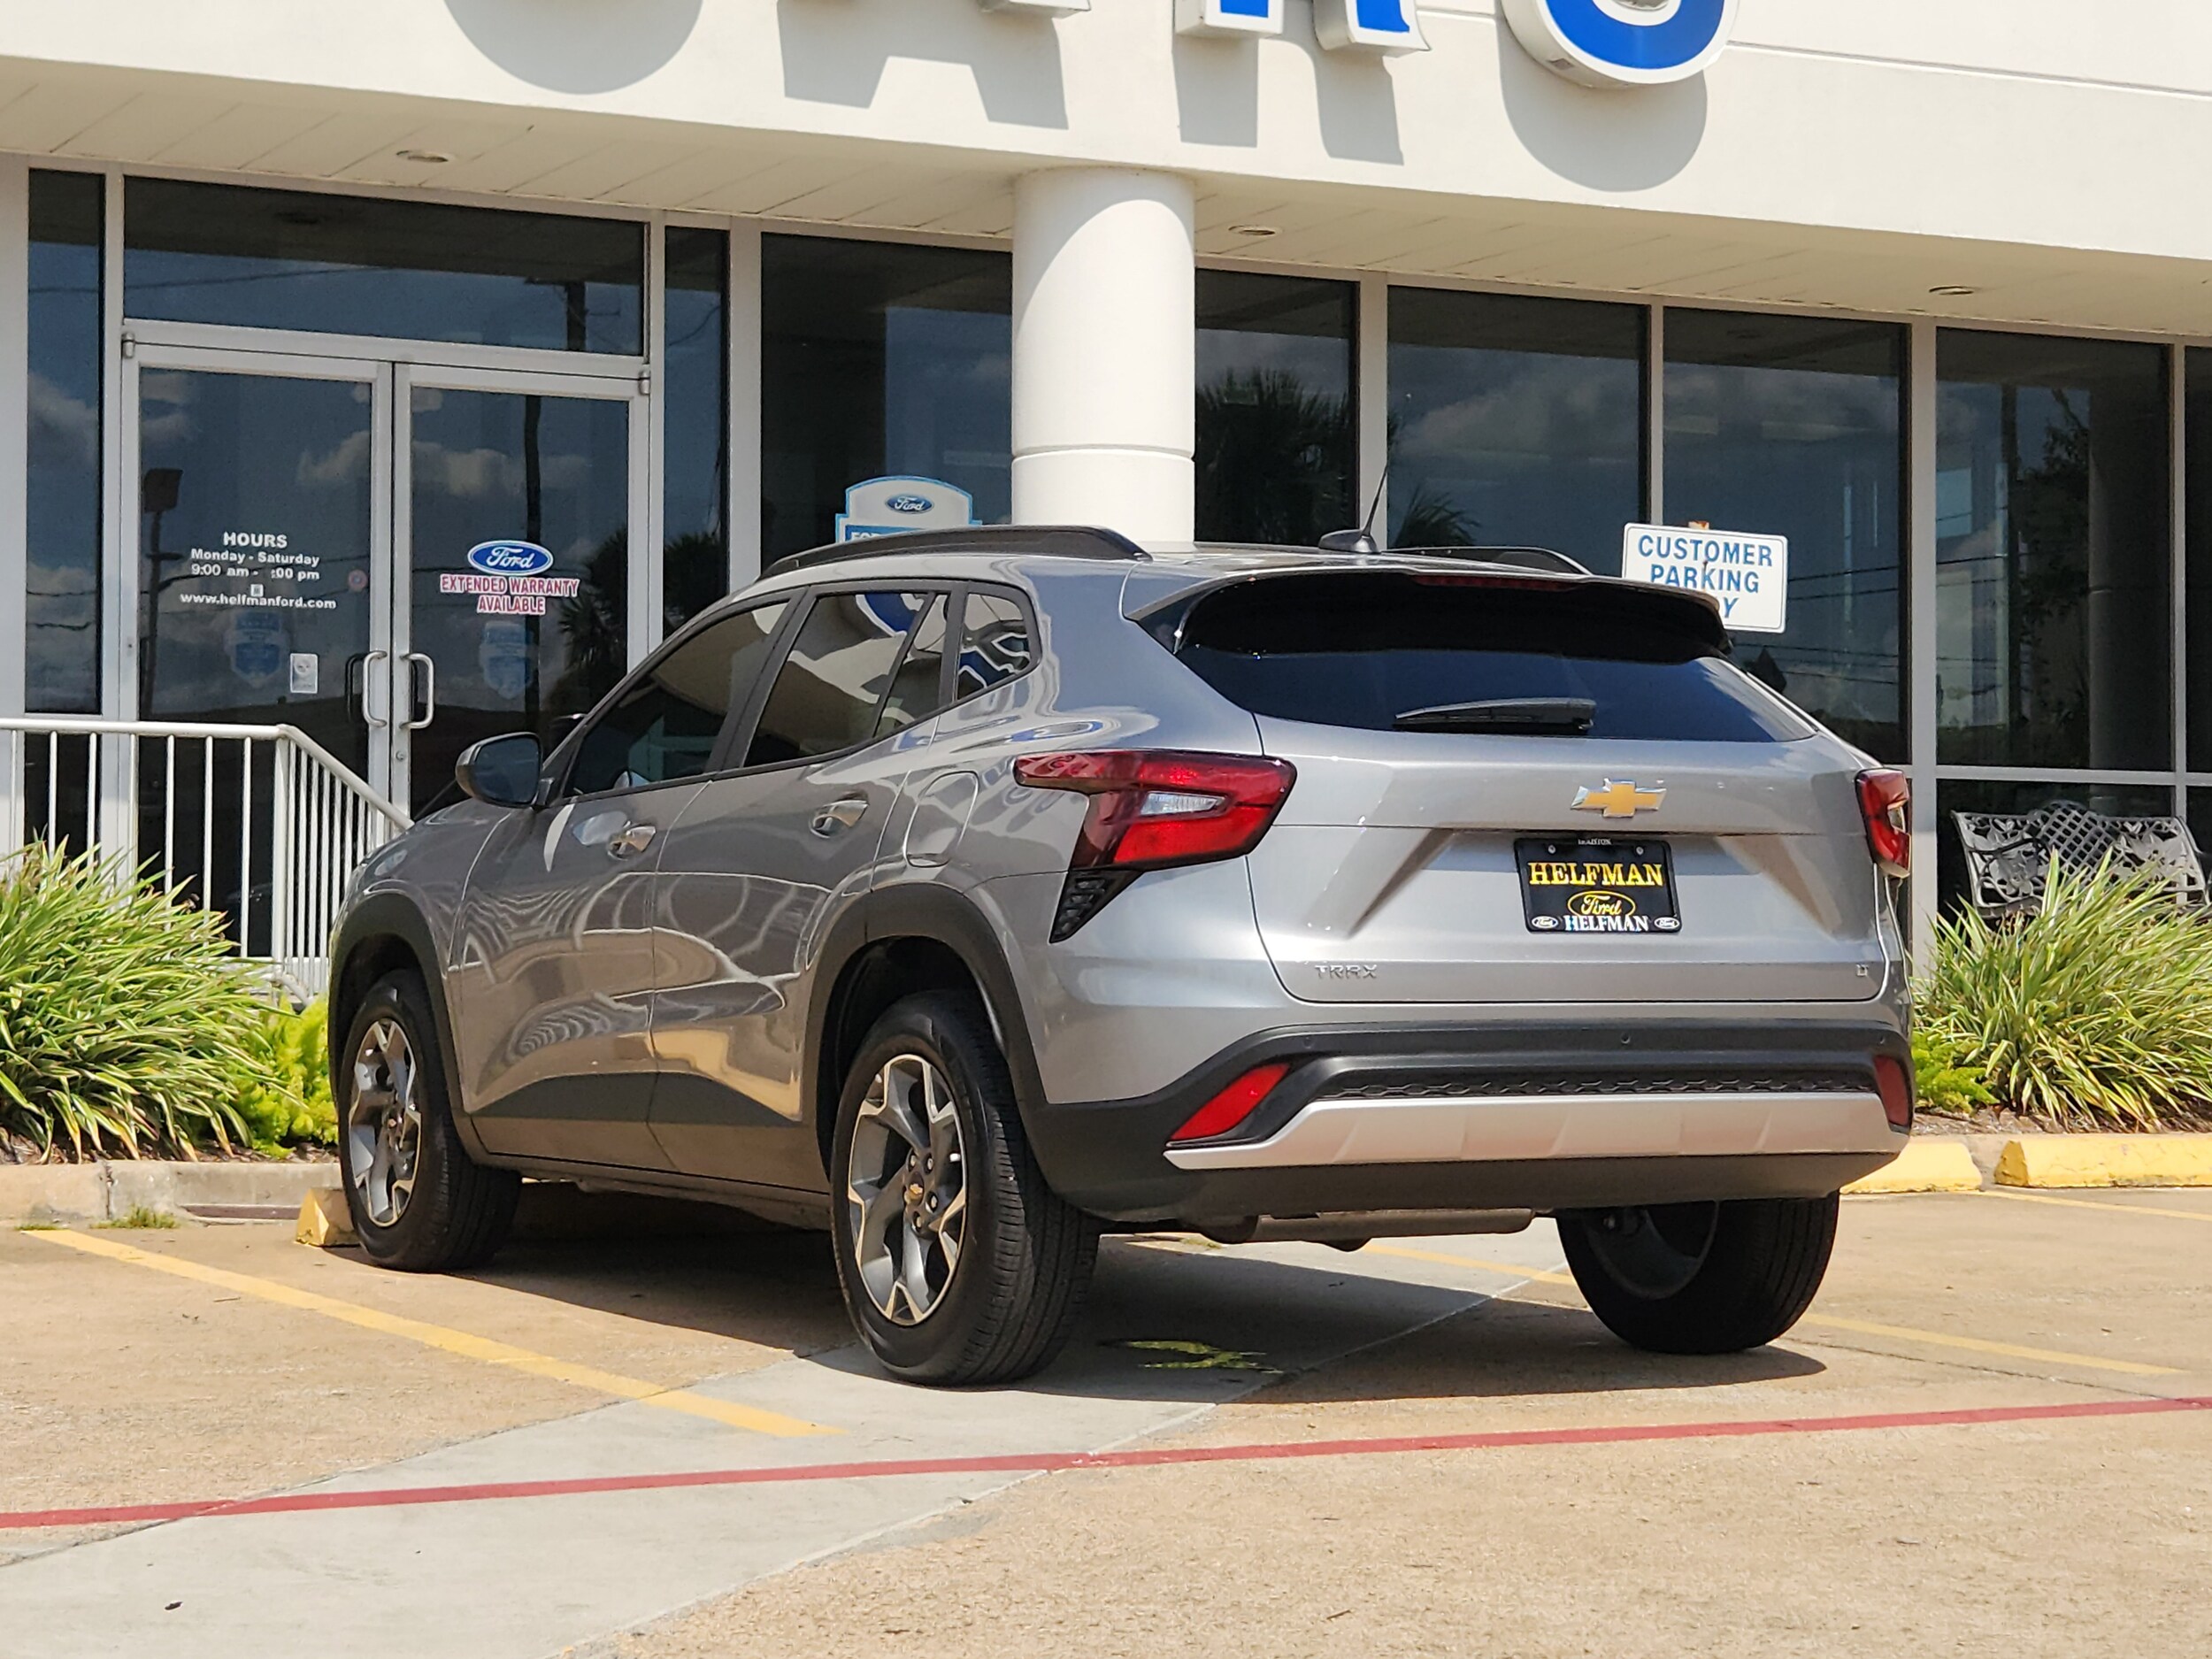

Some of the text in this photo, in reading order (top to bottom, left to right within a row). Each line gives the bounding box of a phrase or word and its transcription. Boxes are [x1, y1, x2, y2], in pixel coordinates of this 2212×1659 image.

[223, 531, 288, 549] HOURS
[191, 548, 246, 565] Monday
[257, 551, 320, 568] Saturday
[1638, 534, 1772, 567] CUSTOMER
[191, 563, 221, 576] 9:00
[227, 567, 250, 578] am
[297, 571, 320, 581] pm
[1650, 564, 1760, 594] PARKING
[442, 575, 580, 596] EXTENDED WARRANTY
[180, 593, 337, 609] www.helfmanford.com
[478, 596, 545, 613] AVAILABLE
[1527, 862, 1663, 887] HELFMAN
[1563, 915, 1649, 932] HELFMAN
